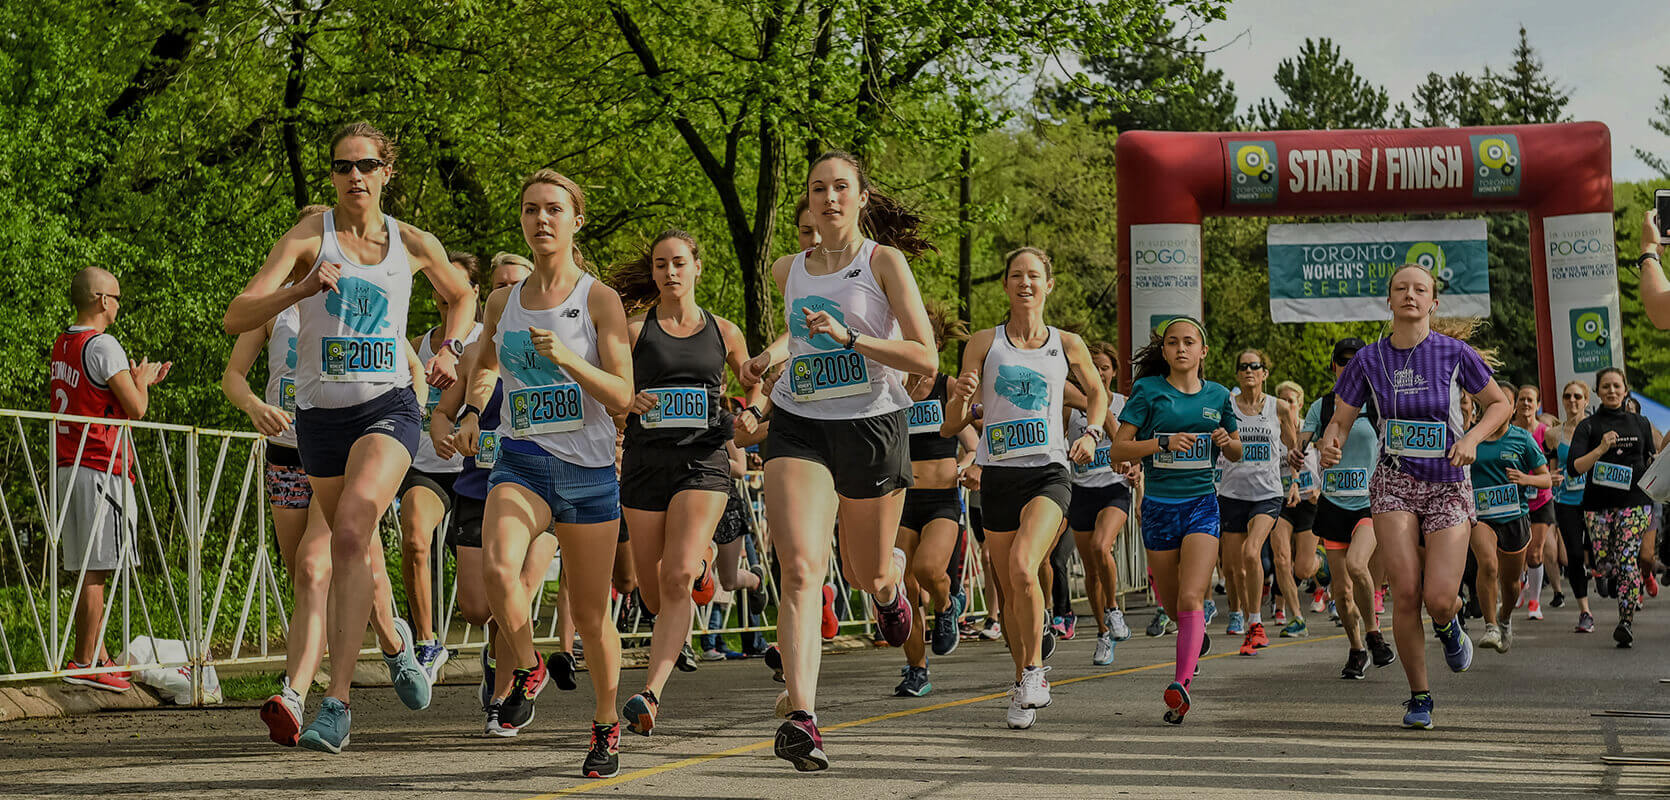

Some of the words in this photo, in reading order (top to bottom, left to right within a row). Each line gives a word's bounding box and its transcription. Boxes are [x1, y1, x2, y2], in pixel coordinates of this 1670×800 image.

[1288, 149, 1361, 192] START
[1385, 146, 1463, 190] FINISH
[1302, 245, 1395, 262] TORONTO
[1302, 263, 1364, 280] WOMEN'S
[1368, 262, 1396, 278] RUN
[1303, 280, 1378, 296] SERIE
[348, 341, 394, 370] 2005
[813, 353, 863, 386] 2008
[56, 388, 70, 434] 2
[530, 388, 578, 421] 2588
[664, 392, 704, 416] 2066
[909, 404, 939, 425] 2058
[1007, 421, 1046, 447] 2006
[1240, 426, 1272, 435] ORONTO
[1406, 425, 1442, 448] 2551
[1088, 450, 1111, 467] 028
[1245, 445, 1270, 461] 2068
[1337, 471, 1365, 489] 2082
[1488, 487, 1515, 506] 2042
